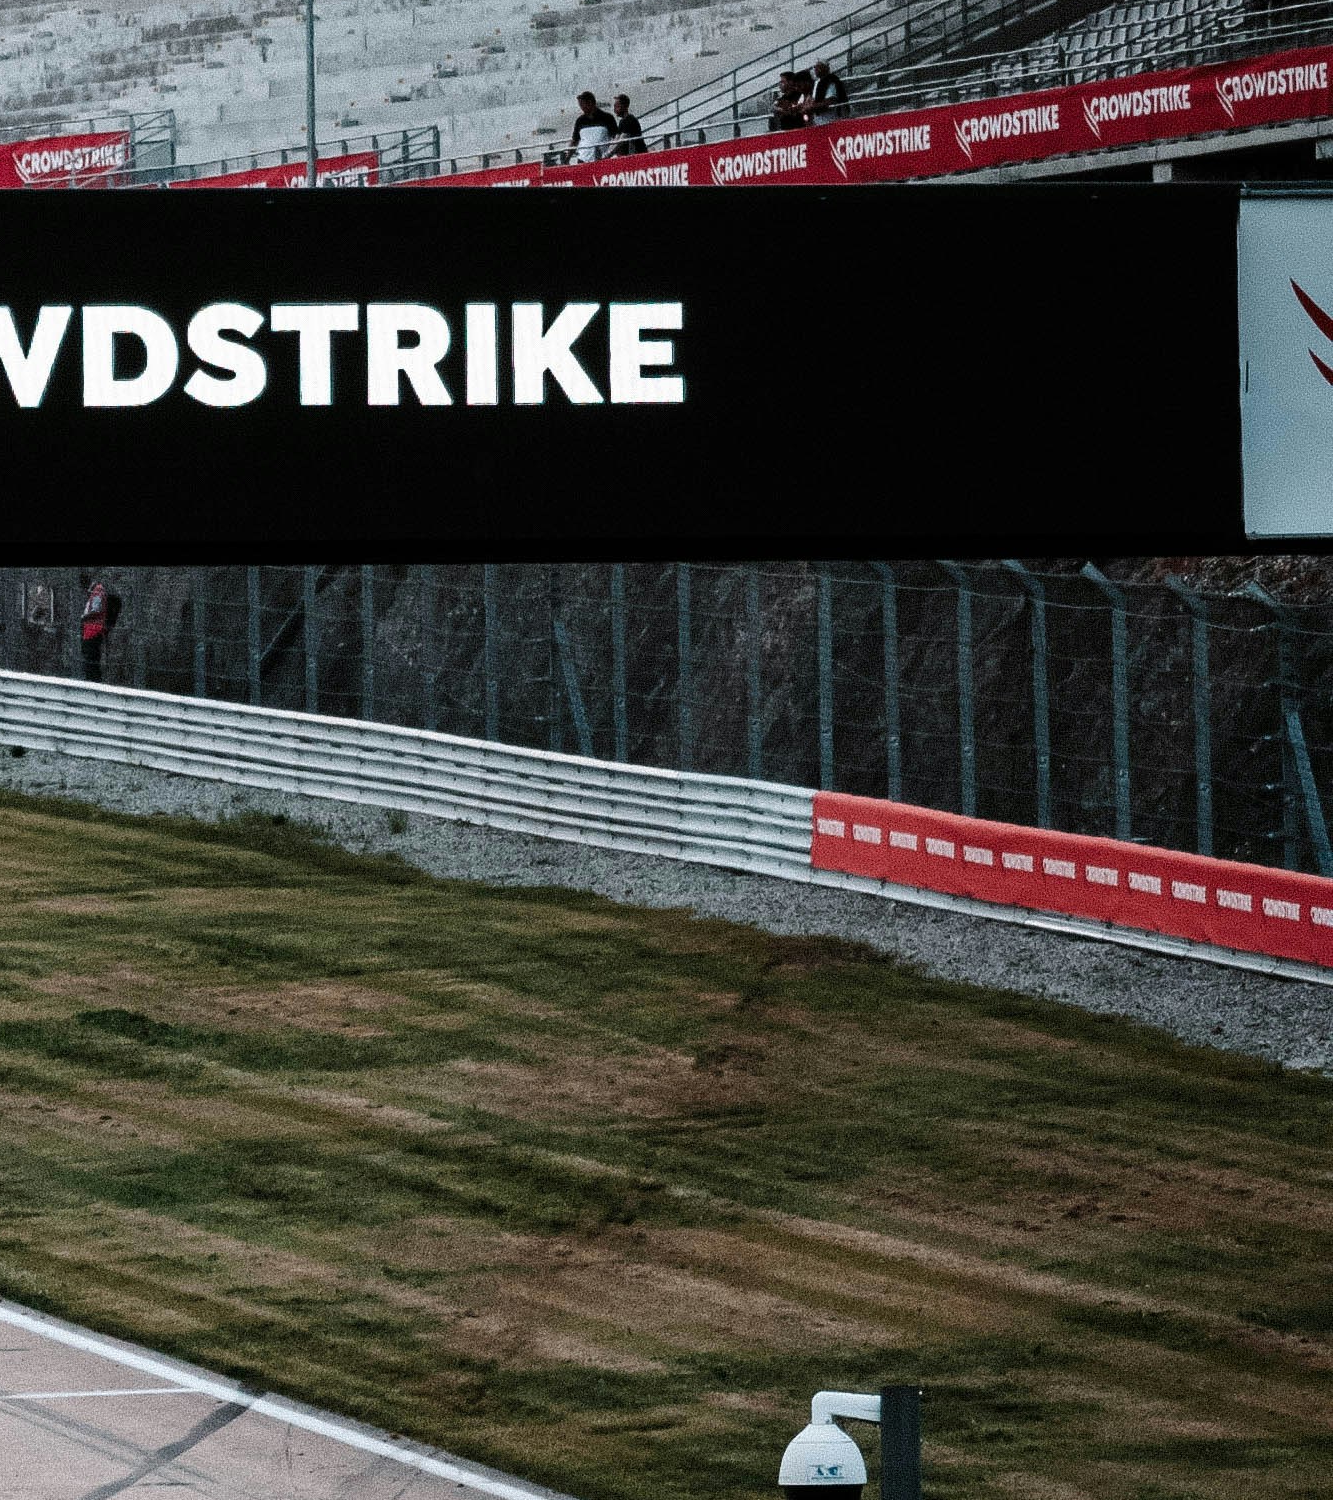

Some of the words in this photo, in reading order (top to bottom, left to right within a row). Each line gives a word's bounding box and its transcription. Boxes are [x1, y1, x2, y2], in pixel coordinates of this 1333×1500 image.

[1223, 62, 1327, 103] CROWDSTRIKE
[1090, 84, 1191, 121] CROWDSTRIKE
[962, 105, 1059, 142] CROWDSTRIKE
[22, 144, 125, 174] CROWDSTRIKE
[836, 125, 931, 161] CROWDSTRIKE
[601, 163, 689, 187] CROWDSTRIKE
[717, 144, 807, 182] CROWDSTRIKE
